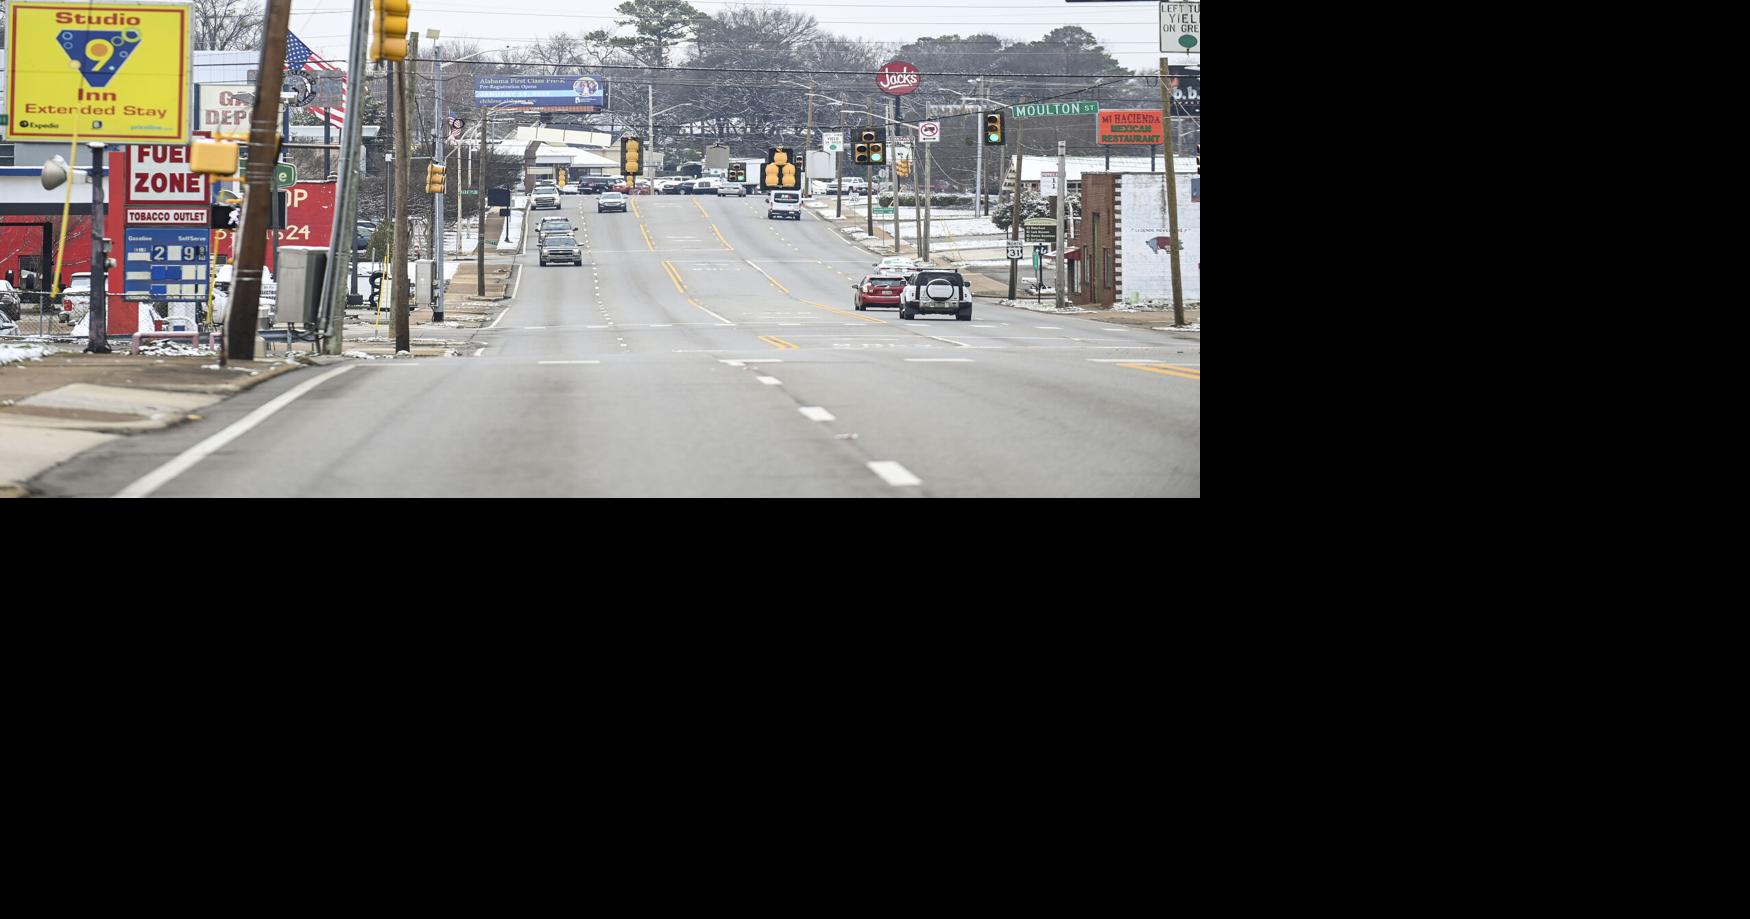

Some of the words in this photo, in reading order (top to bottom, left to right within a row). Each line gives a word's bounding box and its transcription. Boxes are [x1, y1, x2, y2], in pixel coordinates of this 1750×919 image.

[1161, 4, 1185, 13] LEFT
[1188, 4, 1200, 13] TU
[55, 11, 141, 26] Studio
[1168, 13, 1200, 24] YIEL
[1162, 24, 1176, 33] ON
[1180, 24, 1200, 33] GRE
[85, 38, 115, 72] 9
[880, 66, 918, 88] Jack's
[77, 88, 117, 101] Inn
[123, 105, 168, 119] Stay
[1016, 103, 1080, 117] MOULTON
[1102, 115, 1112, 123] MI
[1114, 113, 1160, 123] HACIENDA
[29, 122, 60, 130] Expedia
[134, 172, 200, 193] ZONE
[130, 212, 170, 221] TOBACCO
[173, 212, 205, 221] OUTLET
[154, 246, 165, 260] 2
[184, 246, 195, 261] 9
